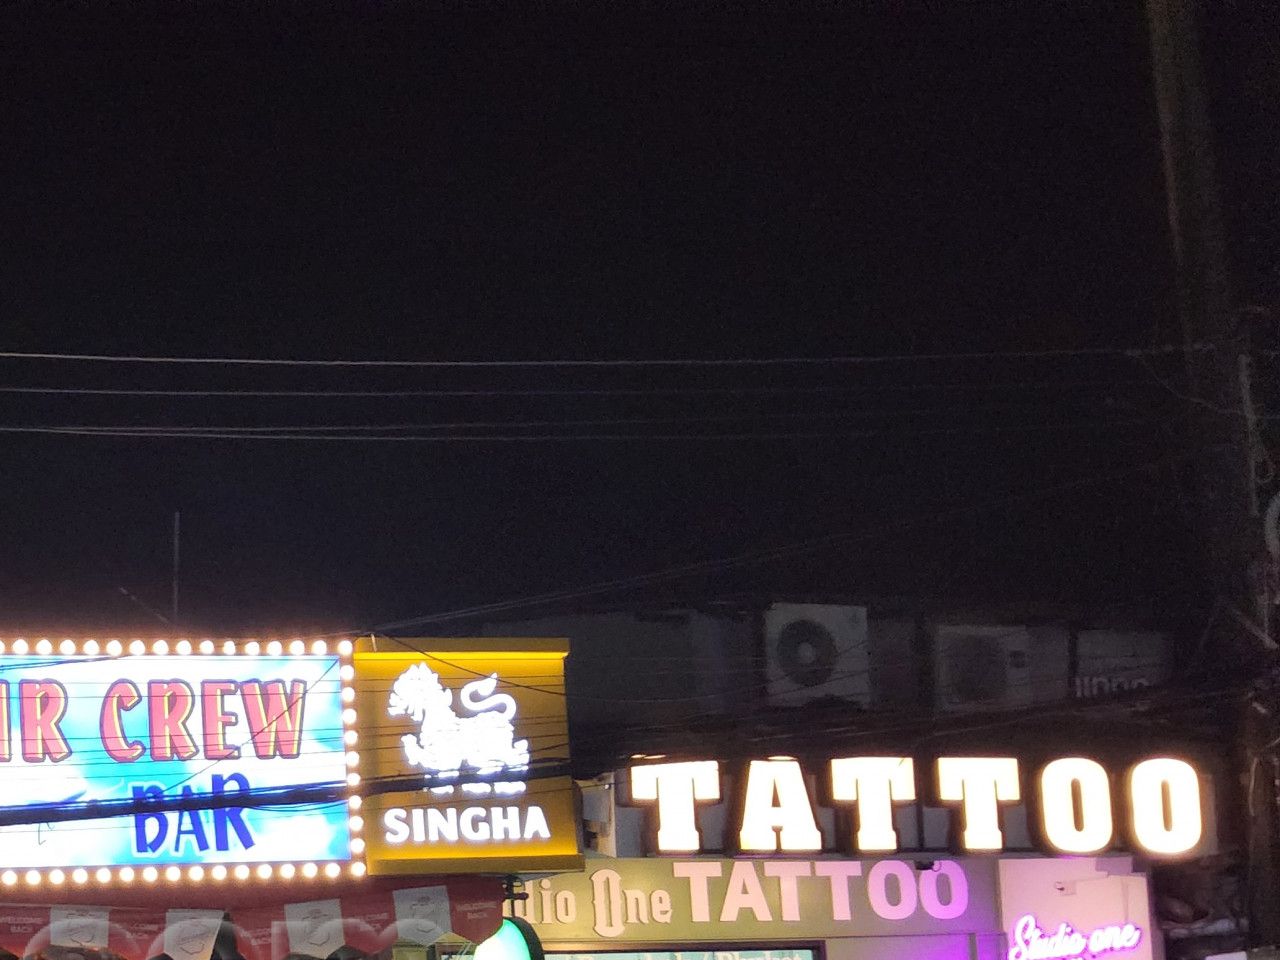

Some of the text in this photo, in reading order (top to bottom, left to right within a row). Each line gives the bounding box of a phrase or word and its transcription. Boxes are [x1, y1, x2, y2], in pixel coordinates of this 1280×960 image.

[99, 678, 308, 763] CREW
[132, 772, 256, 854] BAR
[384, 806, 551, 843] SINGHA
[631, 757, 1203, 852] TATTOO
[589, 869, 672, 937] One
[673, 860, 968, 922] TATTOO
[1089, 924, 1142, 953] one
